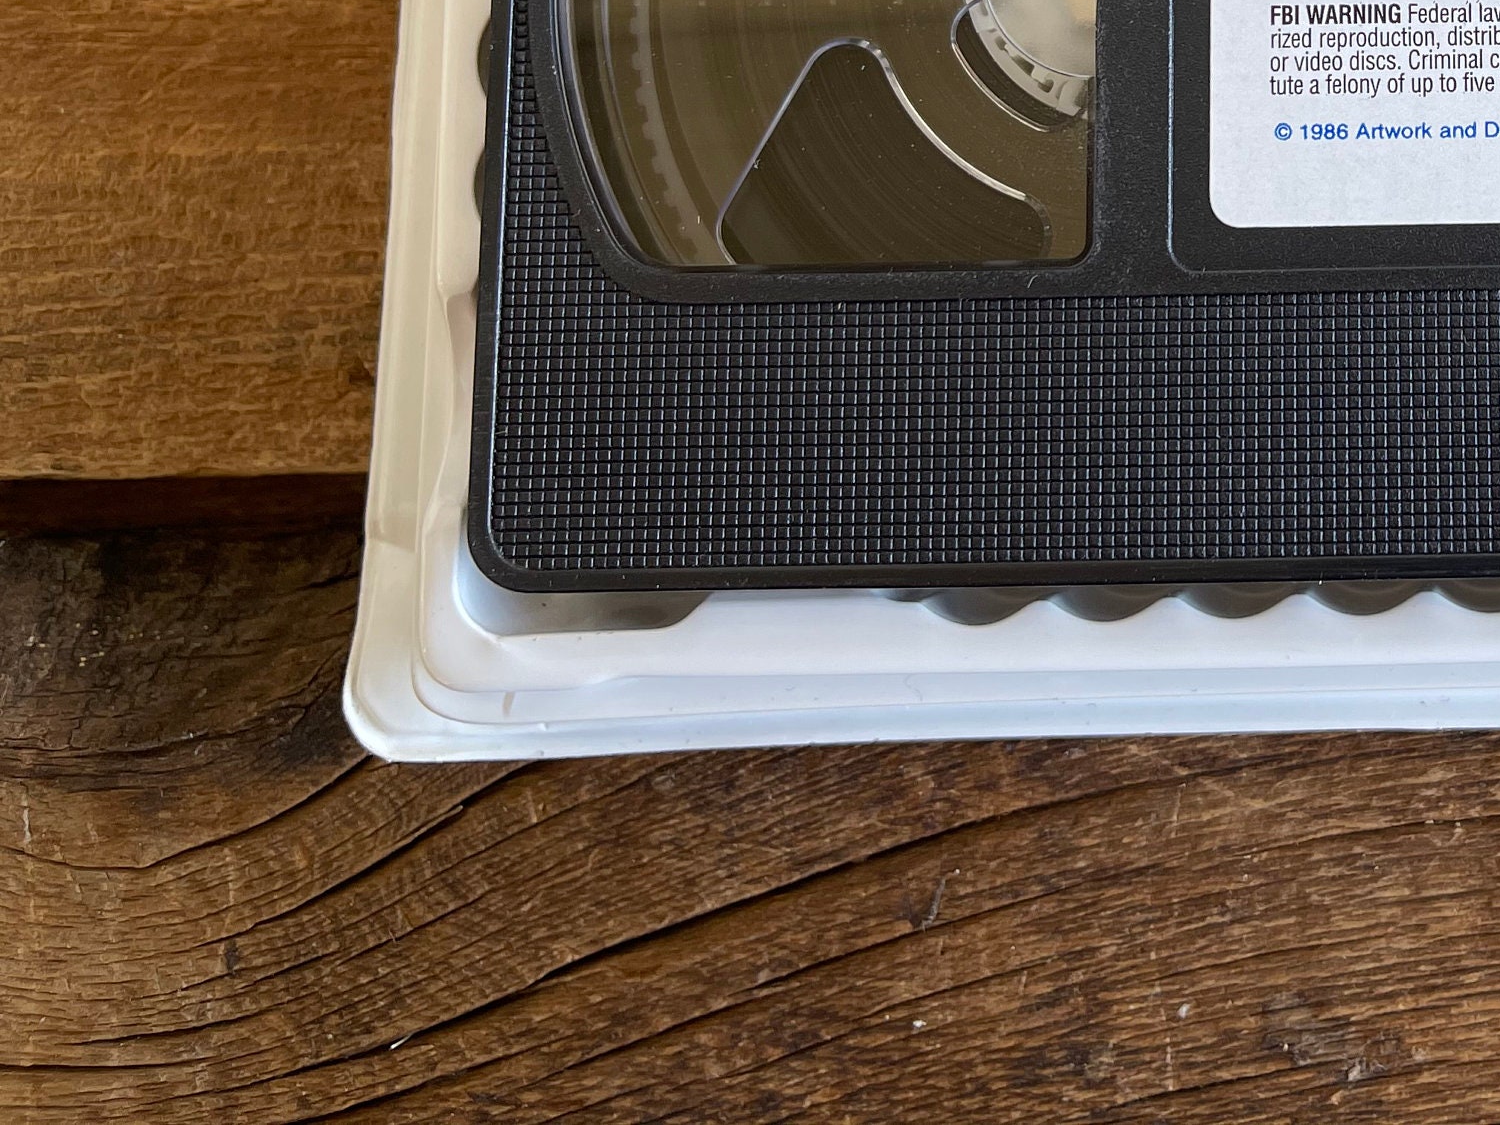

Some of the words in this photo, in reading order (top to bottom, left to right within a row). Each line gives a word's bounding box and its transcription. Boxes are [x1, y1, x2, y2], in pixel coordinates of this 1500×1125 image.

[1271, 5, 1299, 26] FBI
[1306, 3, 1401, 25] WARNING
[1408, 0, 1471, 23] Federal
[1271, 28, 1311, 48] rized
[1320, 26, 1440, 52] reproduction,
[1270, 56, 1289, 72] or
[1294, 51, 1343, 71] video
[1350, 50, 1401, 71] discs.
[1409, 49, 1483, 70] Criminal
[1269, 76, 1303, 95] tute
[1310, 79, 1320, 94] a
[1325, 73, 1381, 98] felony
[1387, 73, 1405, 94] of
[1412, 77, 1433, 97] up
[1439, 73, 1457, 92] to
[1462, 72, 1495, 94] five
[1300, 123, 1348, 140] 1986
[1355, 122, 1432, 139] Artwork
[1440, 121, 1477, 139] and
